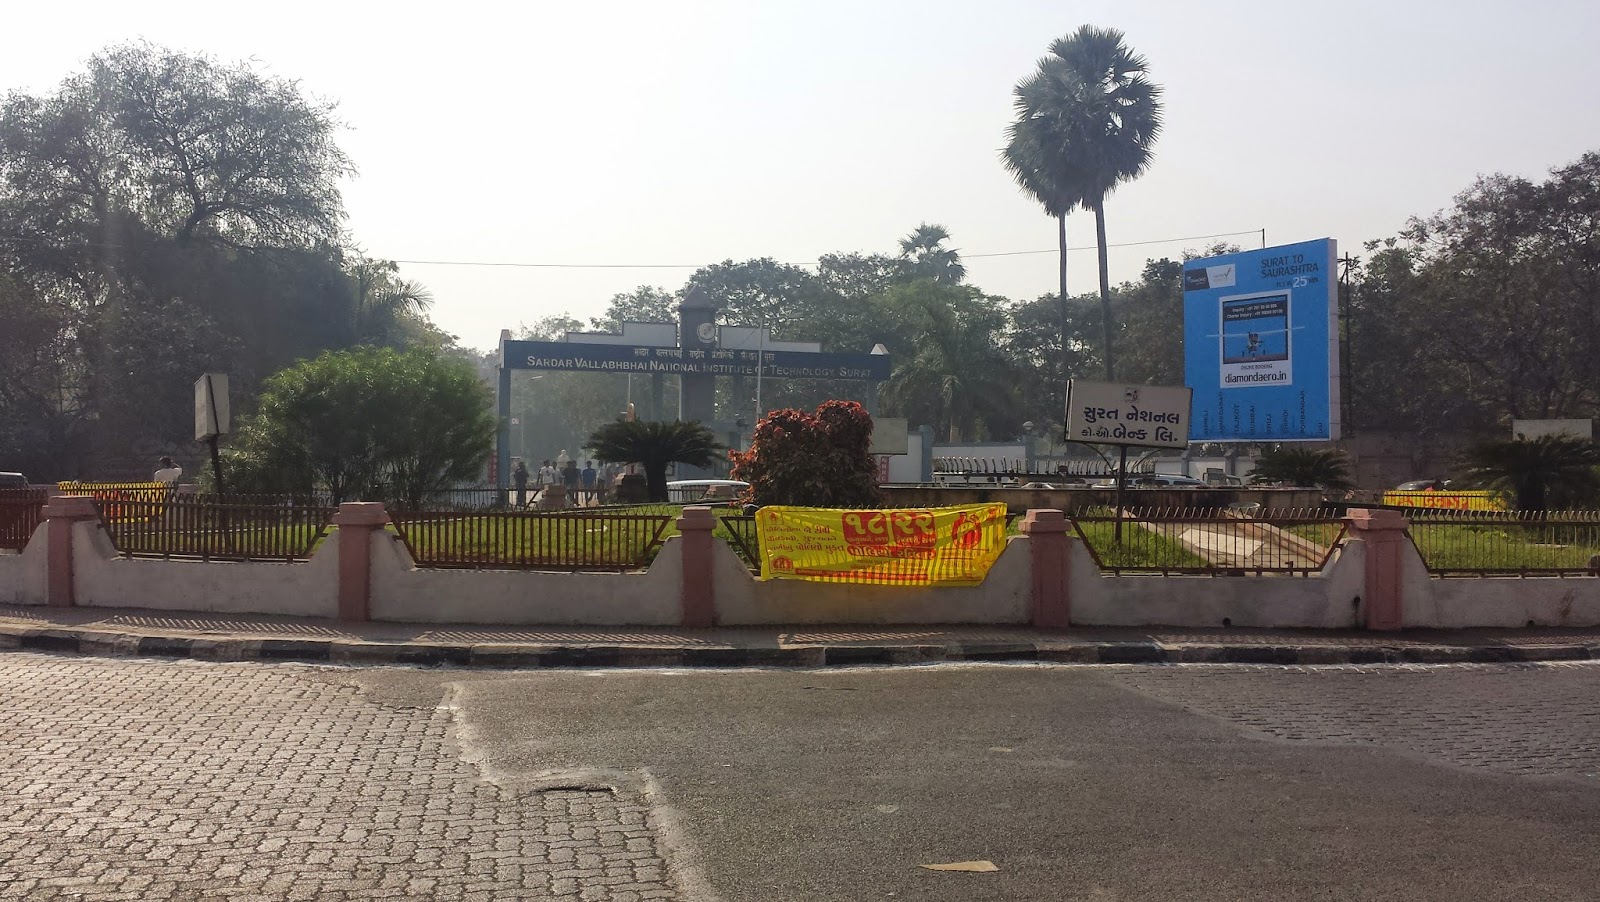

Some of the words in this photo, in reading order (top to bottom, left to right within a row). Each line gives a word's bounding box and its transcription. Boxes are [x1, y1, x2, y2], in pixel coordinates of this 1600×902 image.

[1261, 257, 1288, 268] SURAT
[1292, 254, 1304, 264] TO
[1261, 263, 1318, 278] SAURASHTRA
[527, 356, 572, 368] SARDAR
[574, 358, 647, 370] VALLABHBHAI
[650, 360, 699, 372] NATIONAL
[703, 363, 752, 374] INSTITUTE
[840, 366, 871, 377] SURAT
[1225, 371, 1286, 383] diamondaero.in
[1084, 406, 1118, 423] સુરત
[1126, 406, 1179, 424] નેશનલ
[1155, 426, 1178, 442] લિ.
[845, 512, 885, 534] ૧૮
[895, 513, 932, 534] ૨૨
